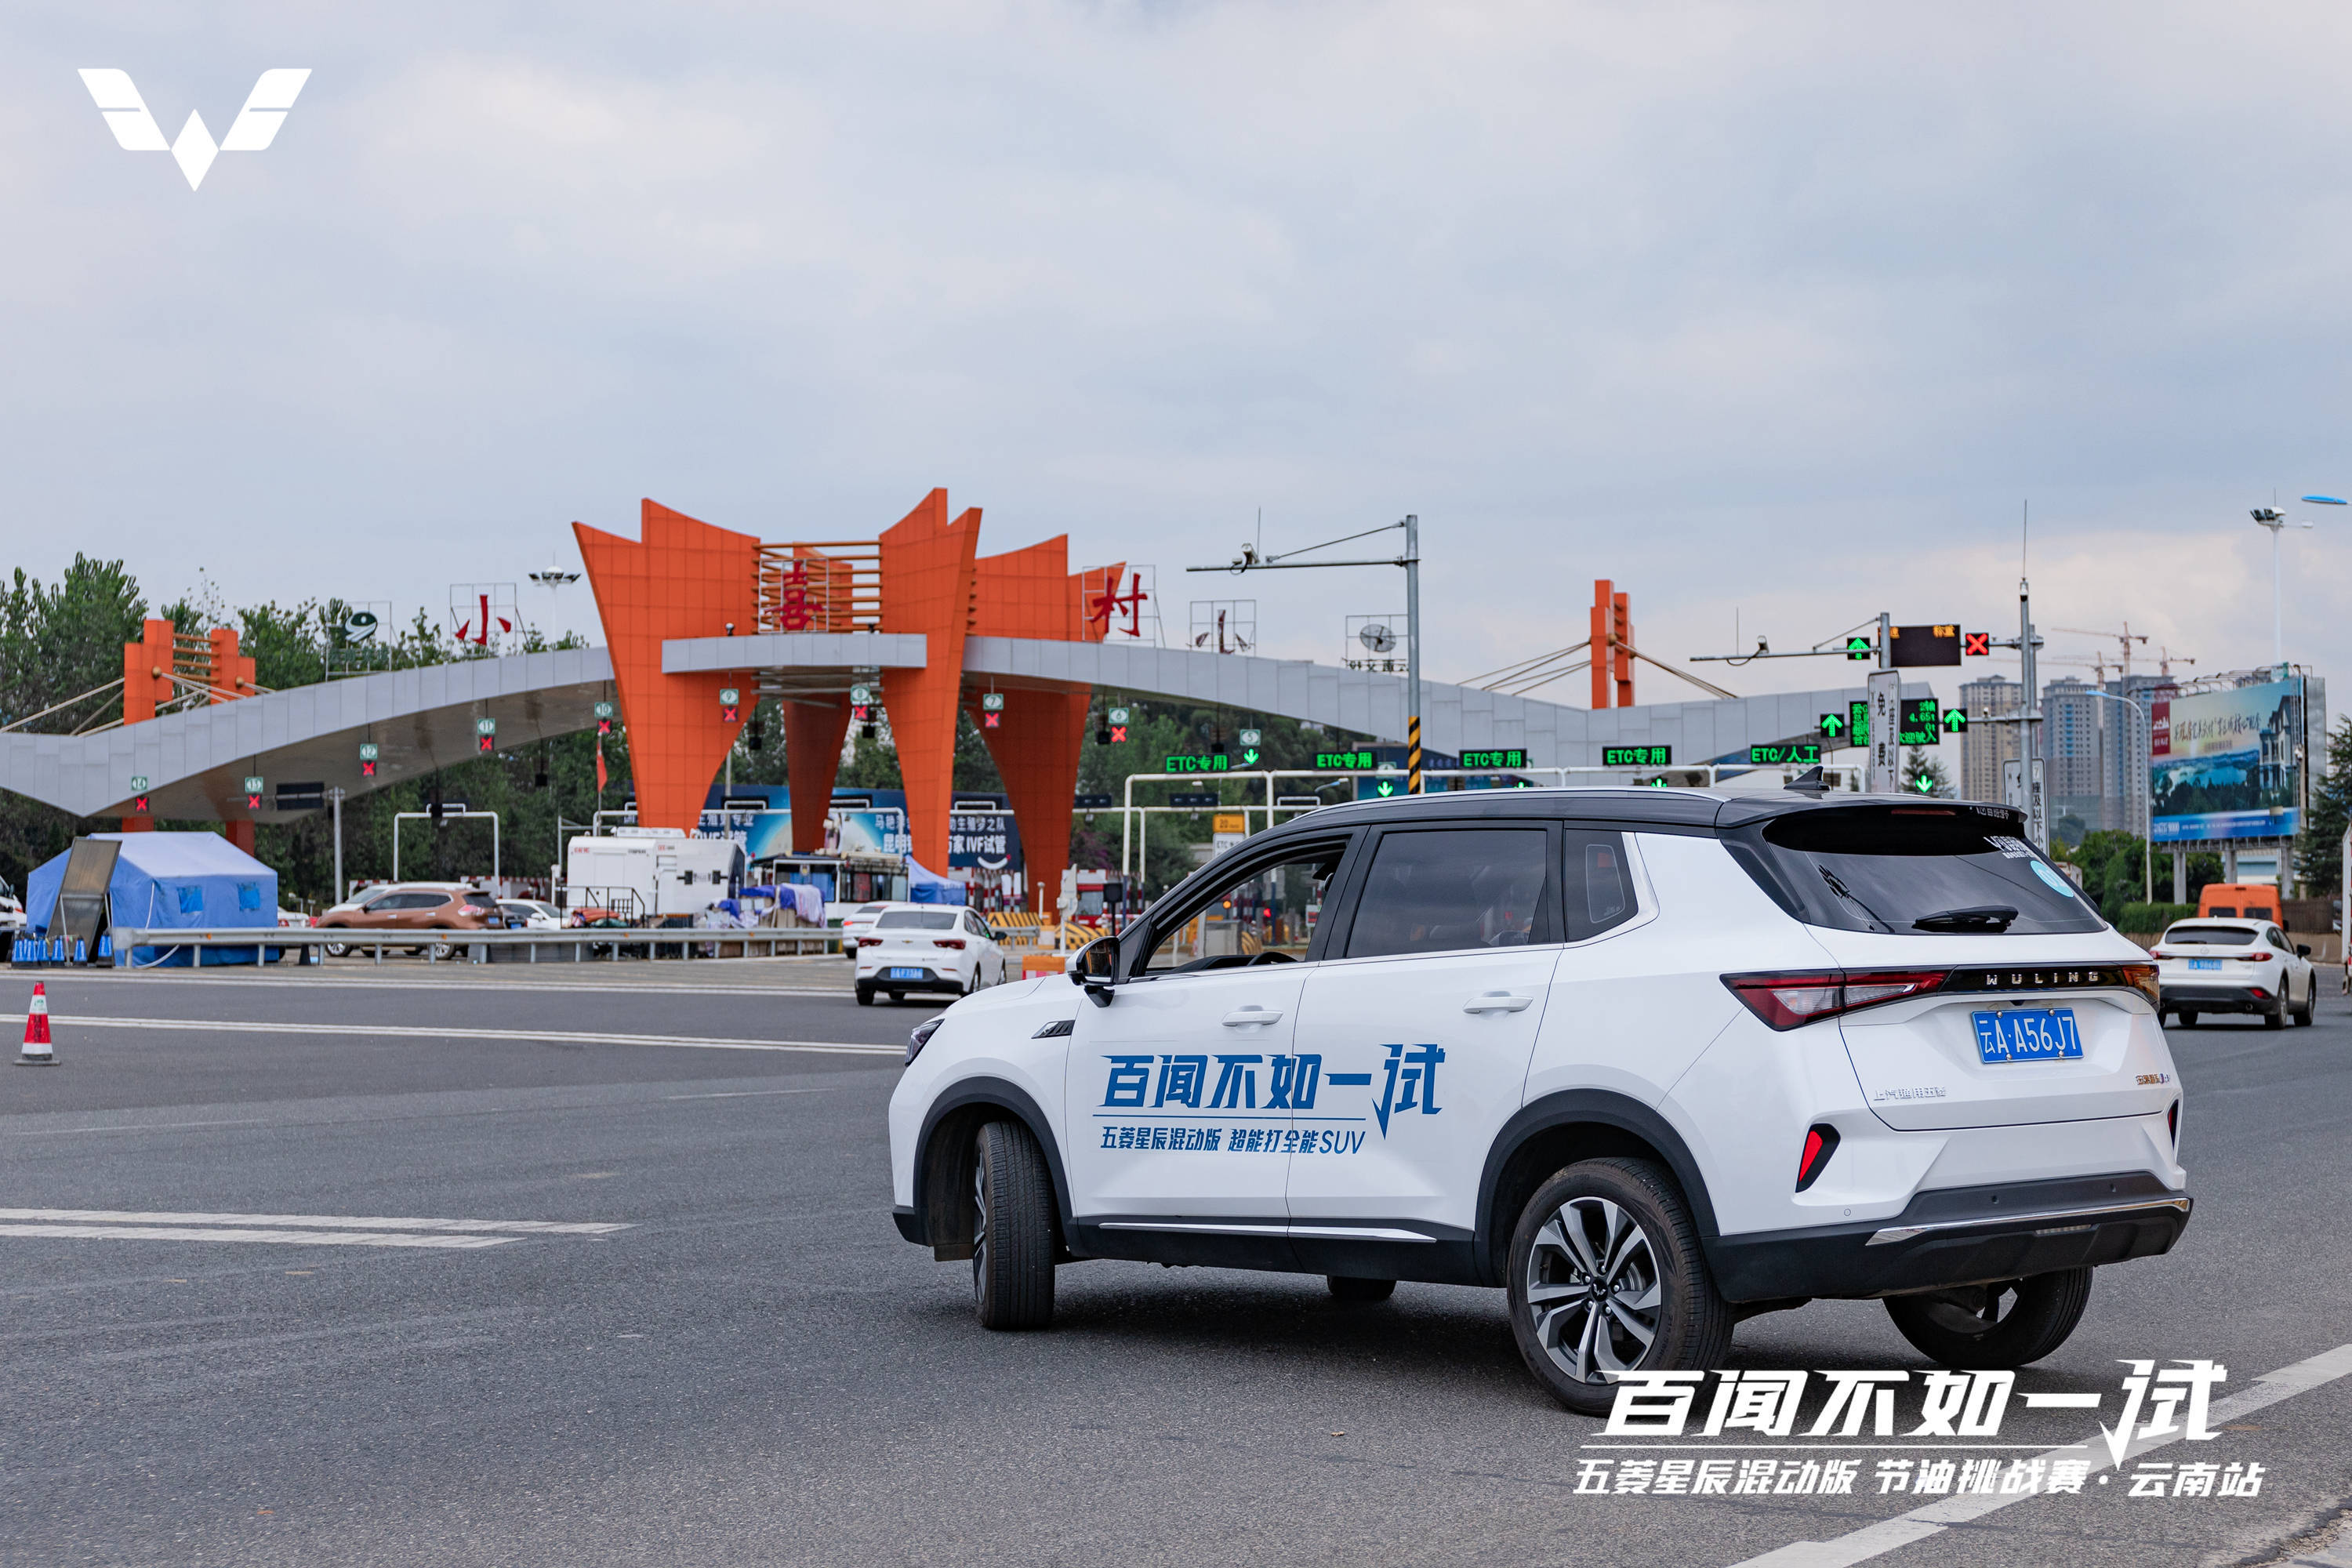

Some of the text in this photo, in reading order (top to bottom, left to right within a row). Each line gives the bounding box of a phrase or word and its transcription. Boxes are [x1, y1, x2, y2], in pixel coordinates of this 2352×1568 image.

[455, 560, 1148, 646] 小 喜 村
[1877, 691, 1886, 767] 免费
[1166, 755, 1228, 772] ETC专用
[1316, 752, 1372, 769] ETC专用
[1464, 750, 1522, 768] ETC专用
[1607, 747, 1666, 764] ETC专用
[1751, 746, 1820, 764] ETC/人工
[1986, 971, 2100, 985] WULING
[1097, 1044, 1446, 1141] 百闻不如一试
[1100, 1126, 1366, 1155] 五菱星辰混动版 超能打全能SUV
